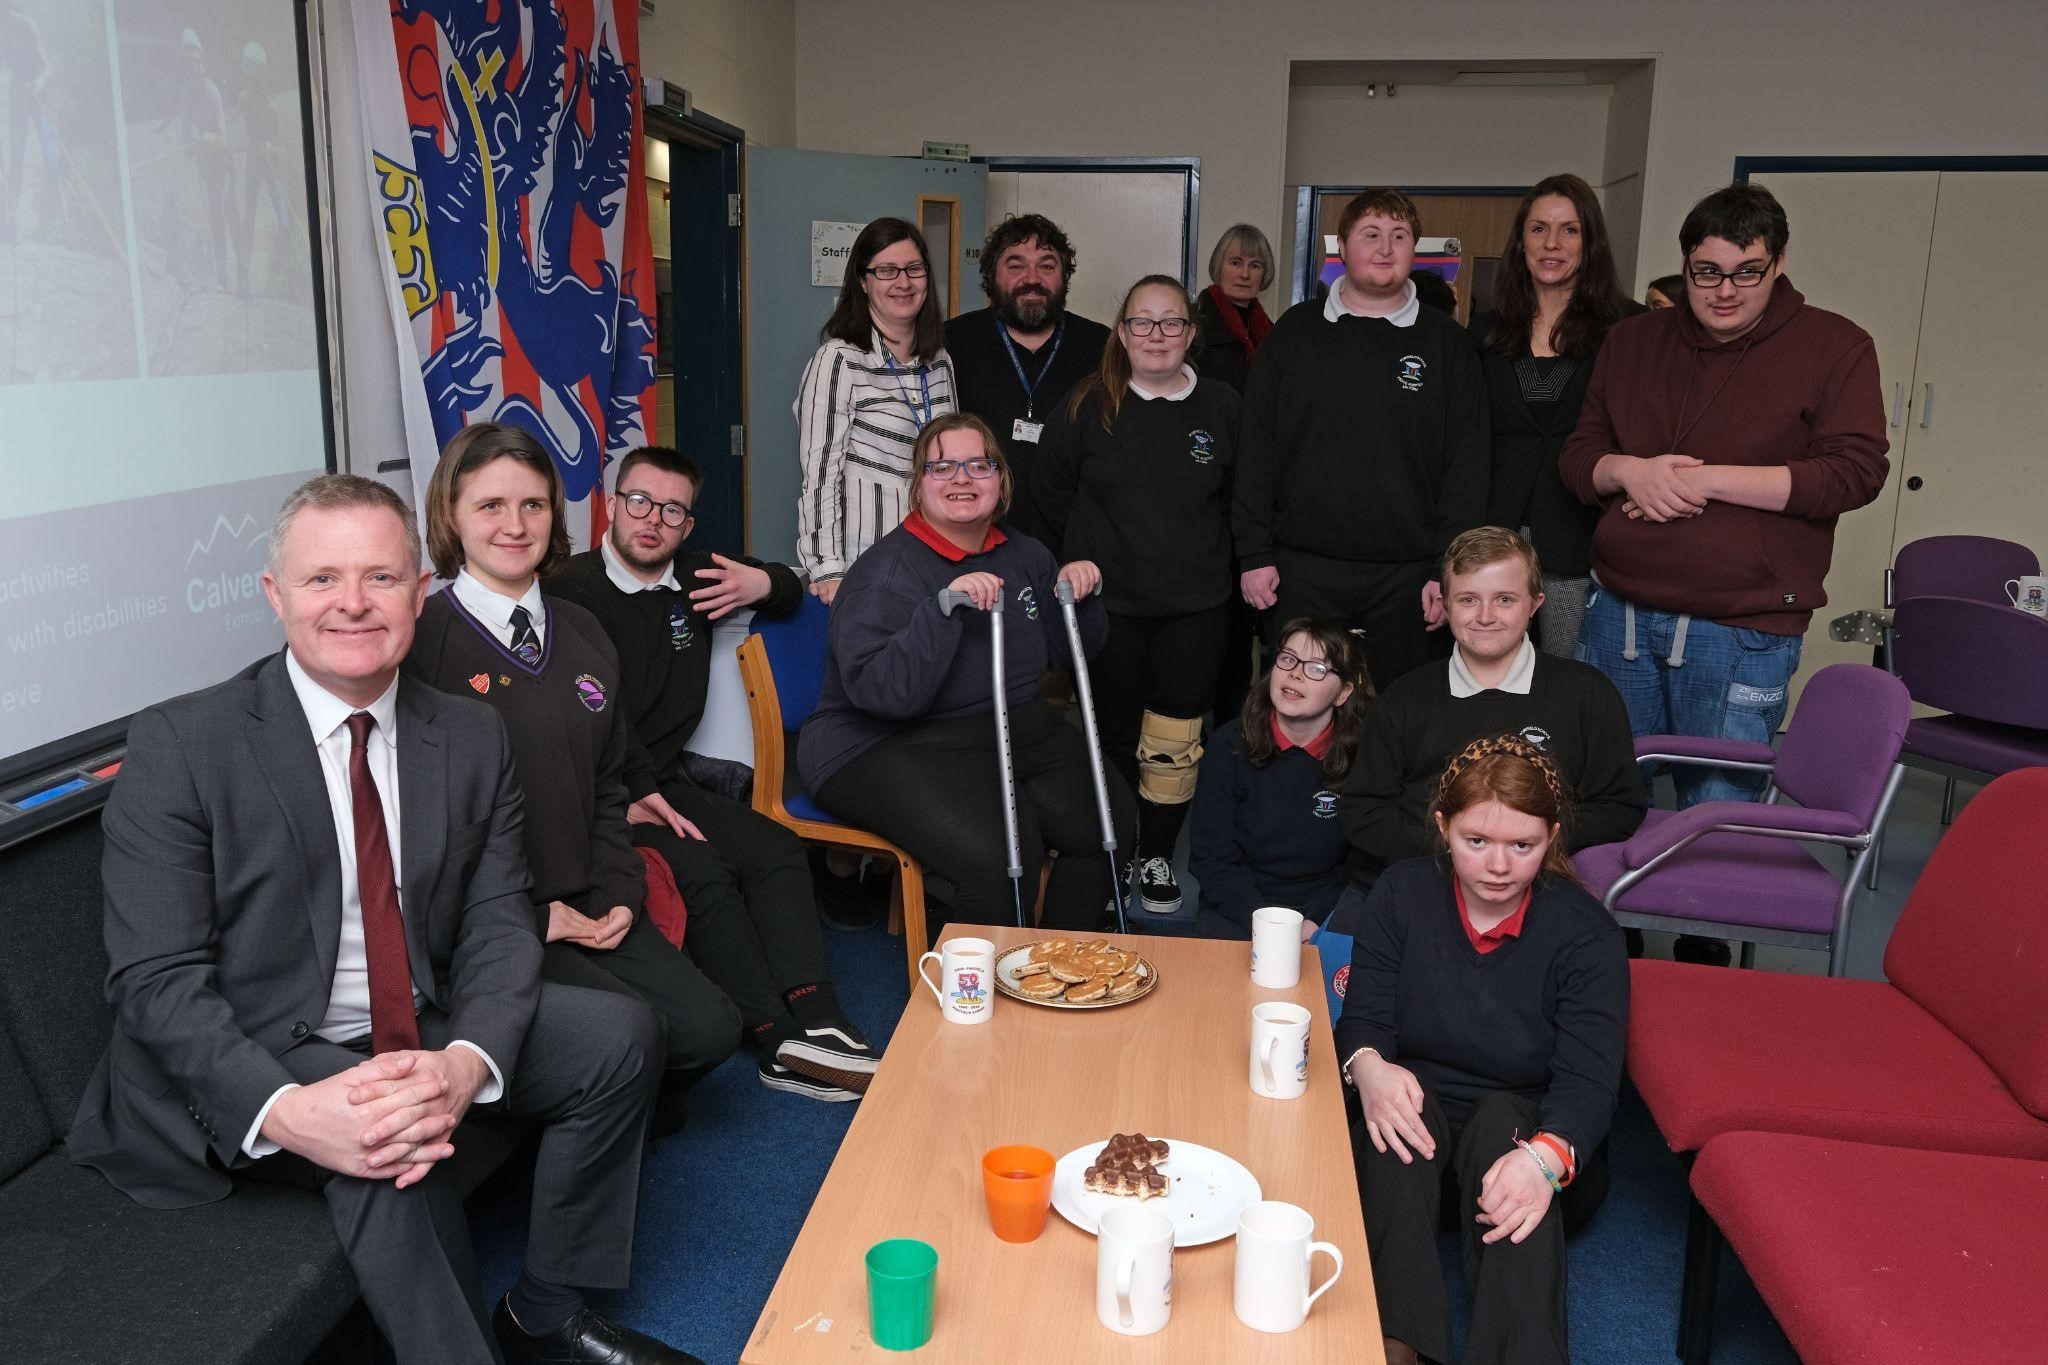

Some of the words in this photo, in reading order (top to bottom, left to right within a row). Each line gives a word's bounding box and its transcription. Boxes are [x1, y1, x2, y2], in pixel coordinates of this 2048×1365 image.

[821, 246, 851, 258] Staff
[0, 562, 90, 601] activities
[187, 563, 268, 614] Calver
[9, 619, 56, 655] with
[64, 594, 168, 640] disabilities
